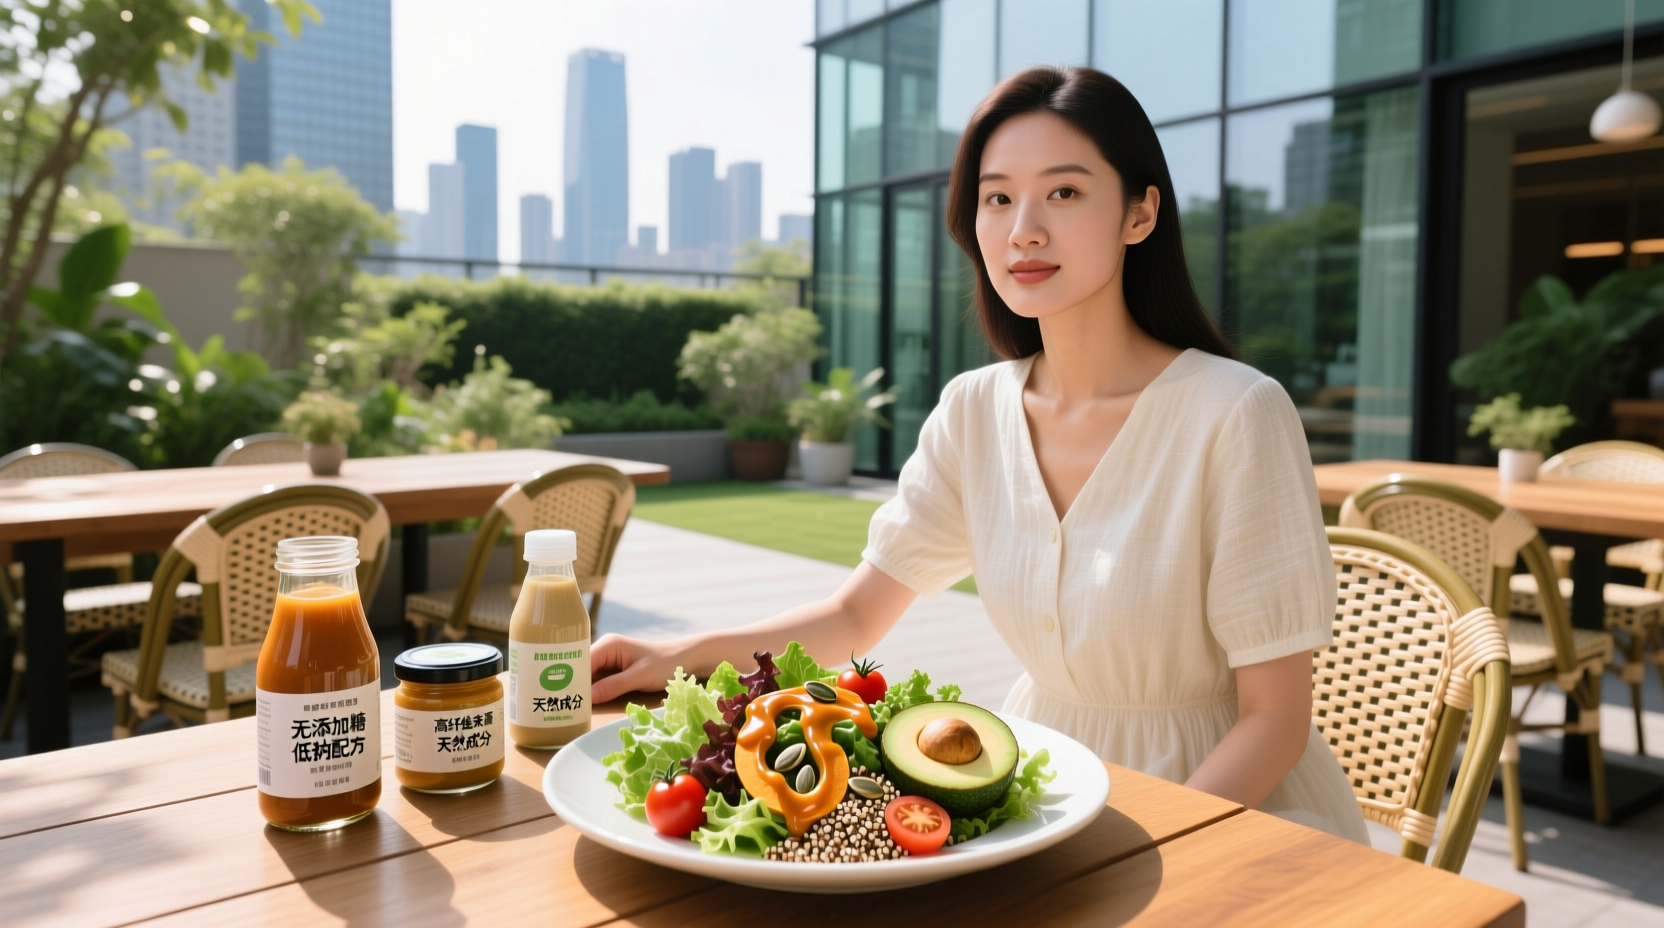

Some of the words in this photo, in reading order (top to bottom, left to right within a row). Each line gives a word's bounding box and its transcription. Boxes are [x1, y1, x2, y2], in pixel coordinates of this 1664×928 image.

[533, 694, 583, 713] 天然成分
[291, 711, 366, 739] 无添加糖
[437, 730, 492, 753] 天然成分
